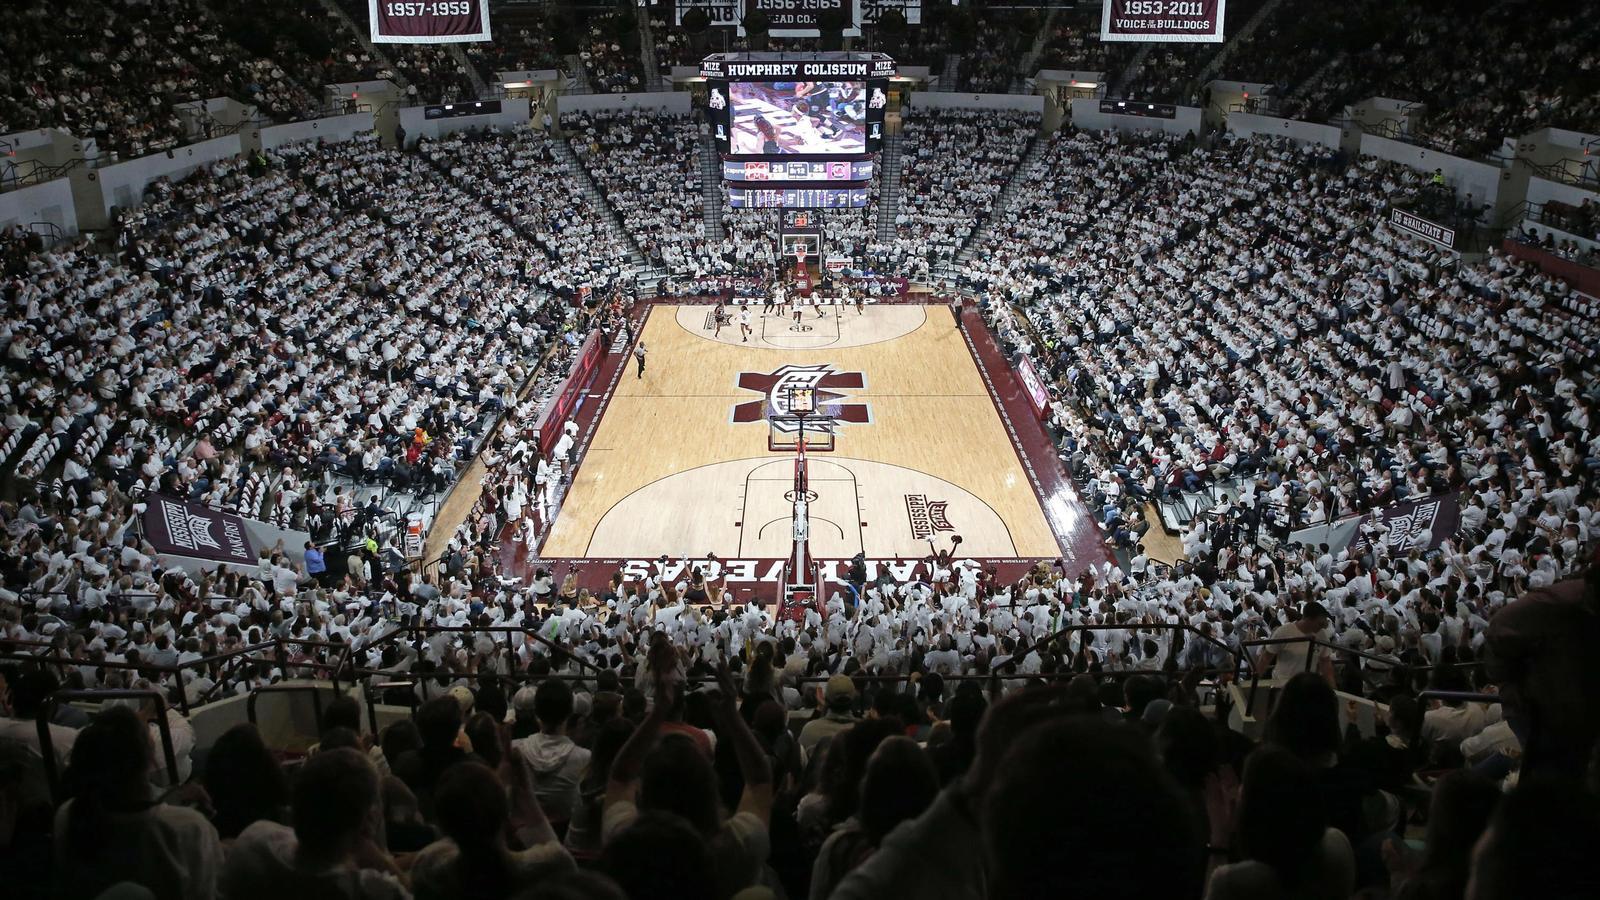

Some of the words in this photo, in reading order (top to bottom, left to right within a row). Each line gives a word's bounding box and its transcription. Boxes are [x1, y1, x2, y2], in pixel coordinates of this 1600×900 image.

[387, 2, 470, 17] 1957-1959
[1124, 0, 1203, 16] 1953-2011
[767, 14, 794, 24] EAD
[1116, 19, 1147, 28] VOICE
[1157, 19, 1210, 30] BULLDOGS
[704, 62, 720, 71] MIZE
[728, 64, 798, 76] HUMPHREY
[804, 63, 867, 75] COLISEUM
[870, 69, 896, 77] FOUNDATION
[875, 61, 892, 71] MIZE
[1403, 216, 1441, 239] #HAILSTATE
[908, 494, 931, 540] MISSISSIPPI
[931, 504, 951, 528] STATE
[165, 501, 194, 549] MISSISSIPPI
[193, 519, 213, 546] STATE
